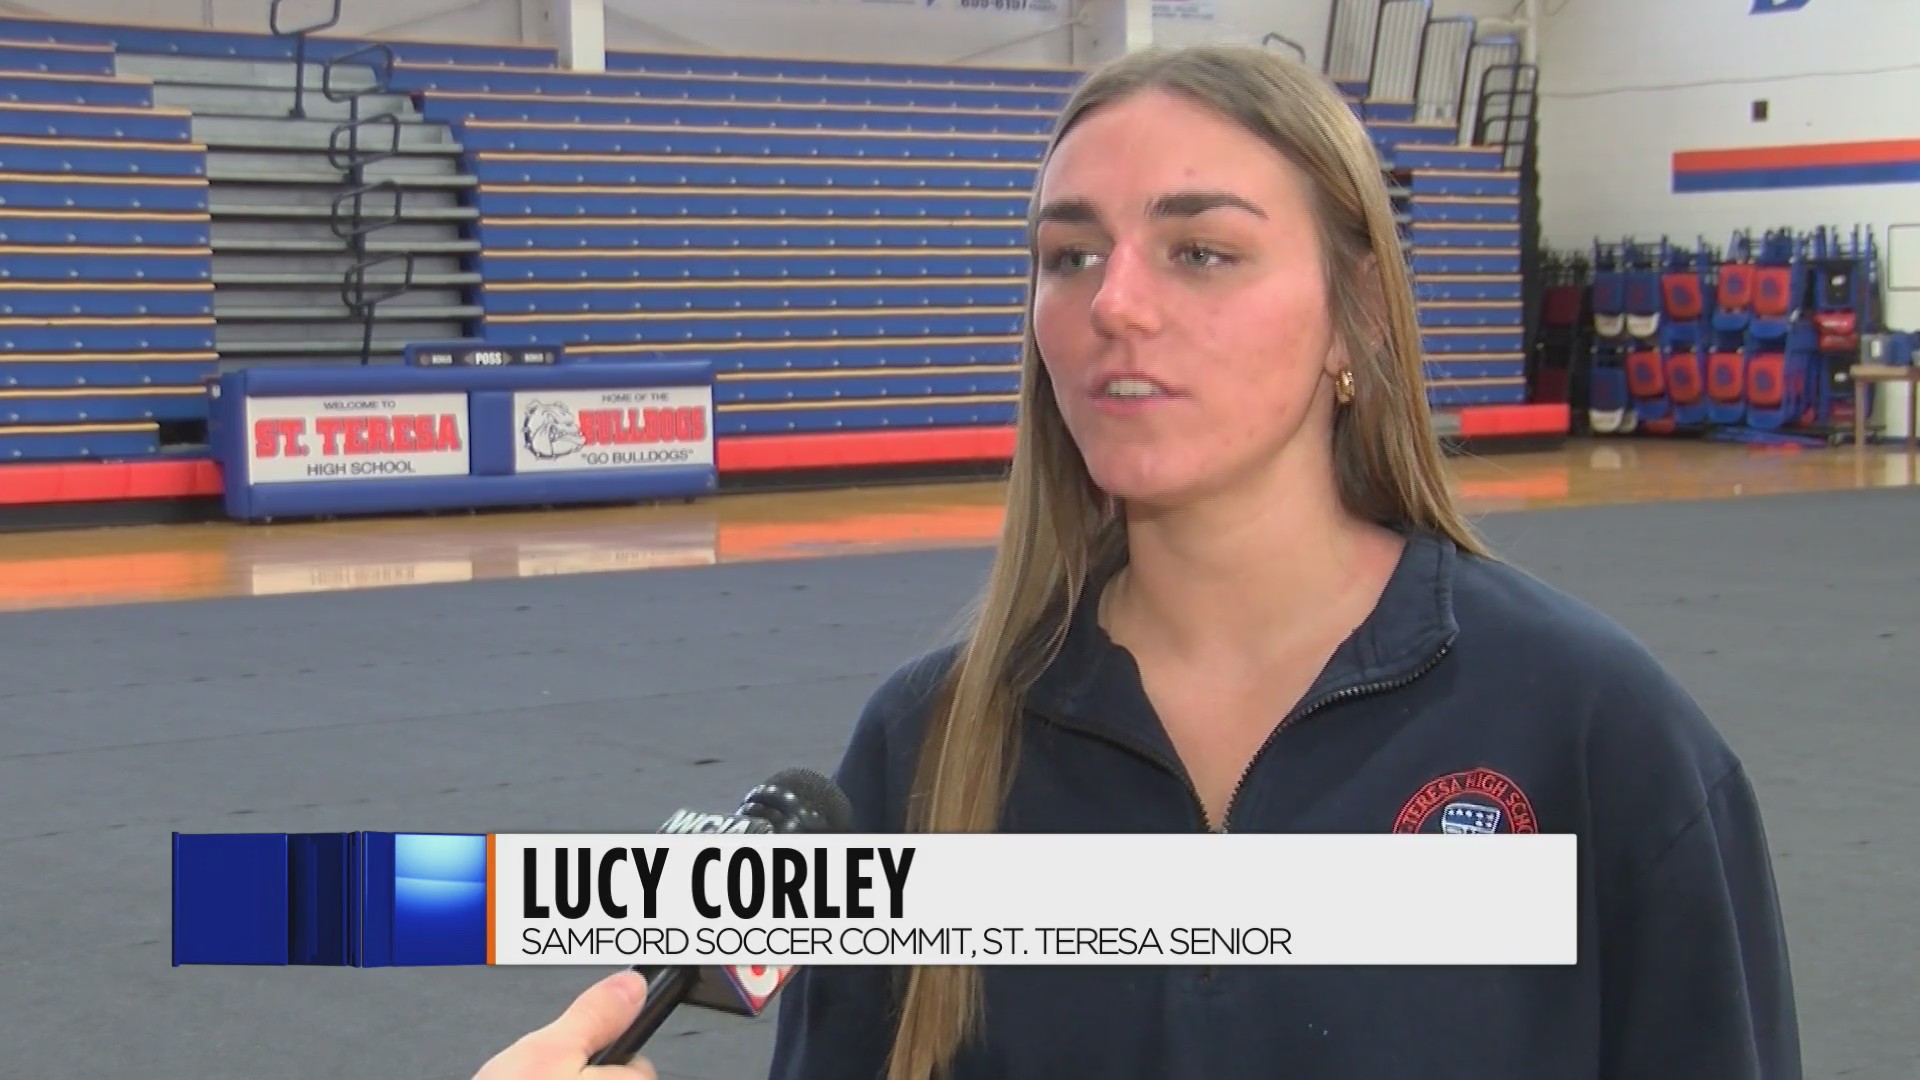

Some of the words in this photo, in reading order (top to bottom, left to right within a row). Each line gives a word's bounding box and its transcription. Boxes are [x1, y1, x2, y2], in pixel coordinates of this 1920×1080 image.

[475, 352, 503, 365] POSS
[323, 401, 378, 411] WELCOME
[381, 401, 396, 410] TO
[602, 394, 630, 403] HOME
[634, 394, 648, 402] OF
[651, 393, 670, 401] THE
[578, 406, 707, 446] BULLDOGS
[254, 417, 311, 458] ST.
[315, 414, 462, 456] TERESA
[581, 453, 609, 466] "GO
[612, 449, 694, 464] BULLDOGS"
[307, 463, 347, 477] HIGH
[351, 460, 417, 475] SCHOOL
[1402, 776, 1463, 825] TERESA
[1465, 772, 1509, 798] HIGH
[1505, 791, 1535, 835] SCHO
